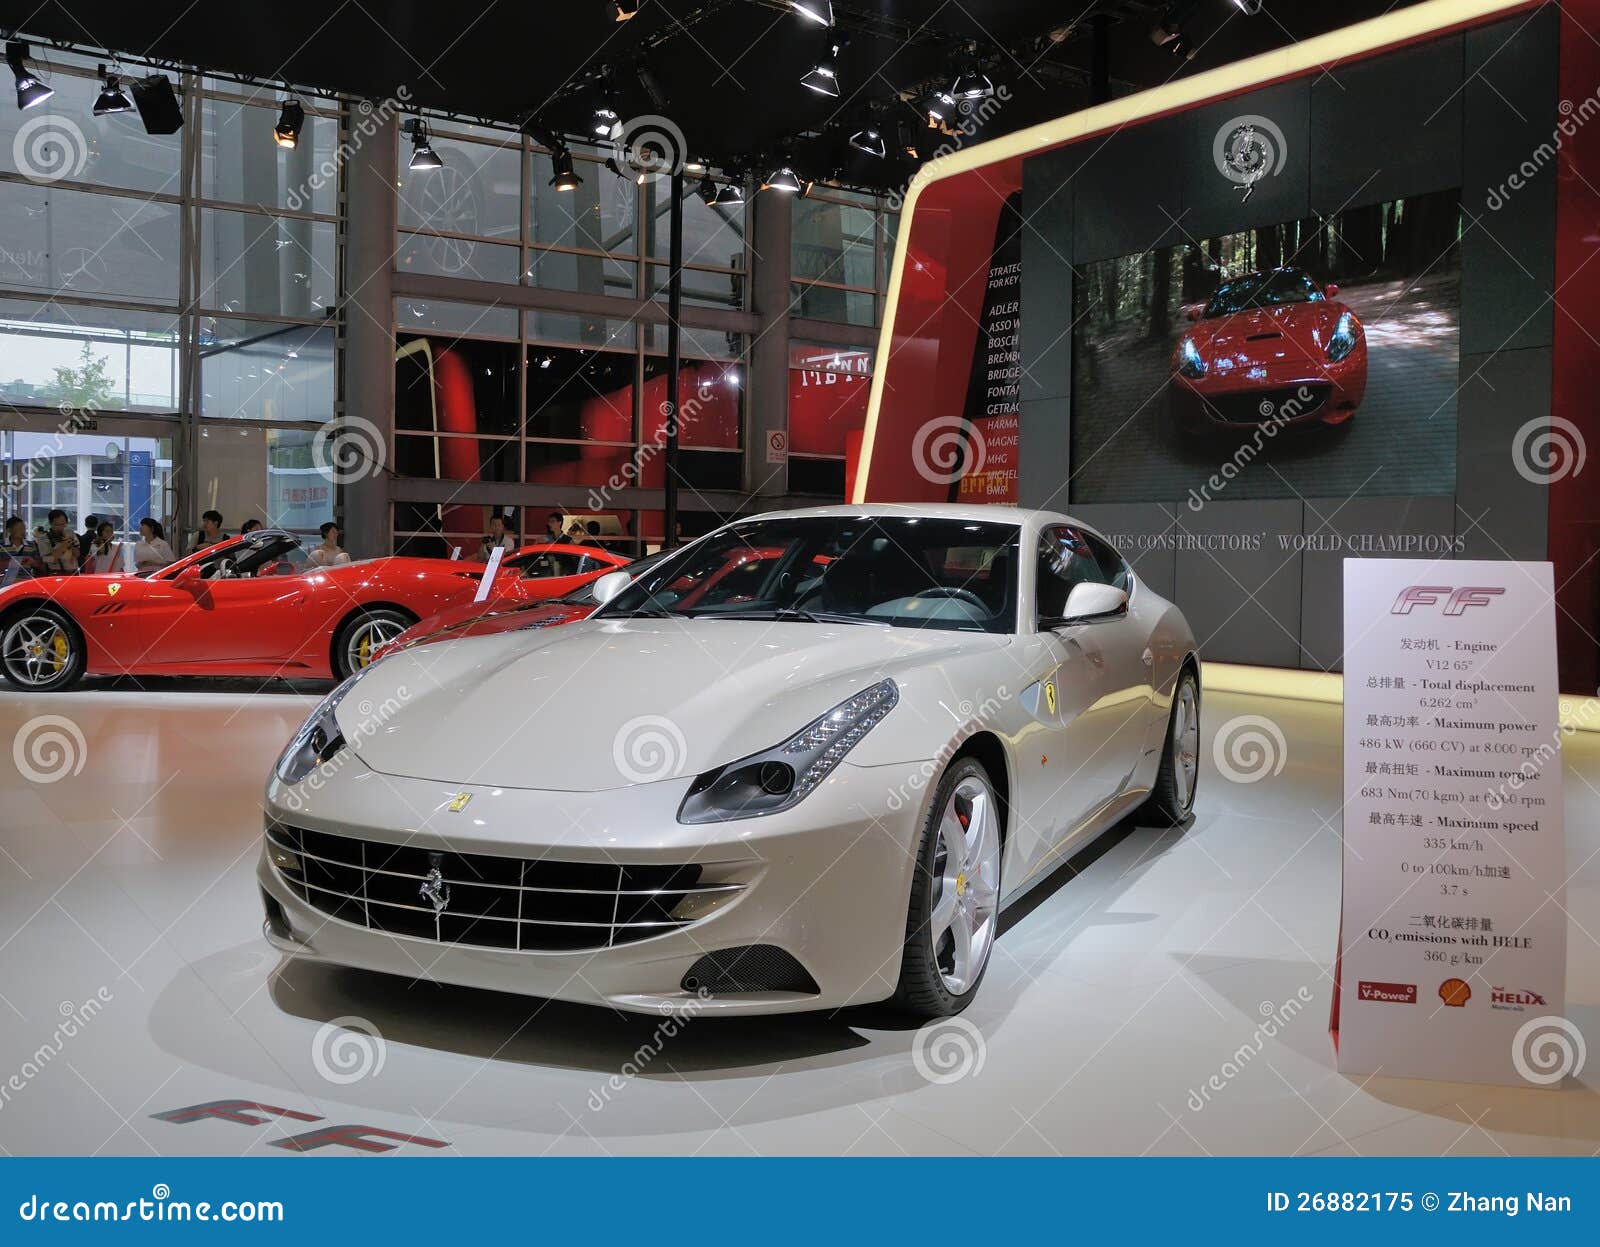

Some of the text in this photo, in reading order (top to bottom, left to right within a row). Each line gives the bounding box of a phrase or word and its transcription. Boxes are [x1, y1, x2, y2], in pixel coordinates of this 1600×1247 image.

[989, 279, 1003, 289] FOR
[988, 302, 1019, 317] ADLER
[988, 320, 1012, 333] ASSO
[988, 334, 1019, 349] BOSCH
[988, 367, 1020, 380] BRIDGE
[987, 418, 1018, 430] HARMA
[987, 435, 1019, 447] MAGNE
[1277, 534, 1342, 551] WORLD
[1349, 534, 1466, 553] CHAMPIONS
[1401, 638, 1440, 650] 发动机
[1455, 640, 1498, 653] Engine
[1426, 659, 1449, 670] V12
[1366, 677, 1406, 690] 总排量
[1420, 679, 1451, 690] Total
[1455, 680, 1536, 694] displacement
[1419, 698, 1452, 708] 6.262
[1366, 714, 1420, 728] 最高功率
[1434, 718, 1495, 730] Maximum
[1499, 722, 1538, 733] power
[1360, 739, 1381, 749] 486
[1385, 739, 1404, 750] kW
[1409, 741, 1437, 752] (660
[1441, 741, 1465, 753] CV)
[1469, 744, 1480, 752] at
[1365, 762, 1419, 776] 最高扭矩
[1434, 766, 1495, 778] Maximum
[1361, 788, 1383, 798] 683
[1469, 793, 1480, 802] at
[1521, 797, 1545, 808] rpm
[1369, 812, 1423, 827] 最高车速
[1437, 816, 1499, 829] Maximum
[1503, 820, 1539, 833] speed
[1424, 838, 1484, 851] 335 km/h
[1401, 863, 1409, 872] 0
[1413, 864, 1425, 873] to
[1440, 885, 1458, 895] 3.7
[1408, 915, 1493, 932] 二氧化碳排量
[1395, 931, 1457, 944] emissions
[1461, 935, 1488, 946] with
[1493, 935, 1533, 949] HELE
[1424, 951, 1447, 962] 360
[1362, 989, 1411, 1001] V-Power
[1491, 991, 1546, 1006] HELIX
